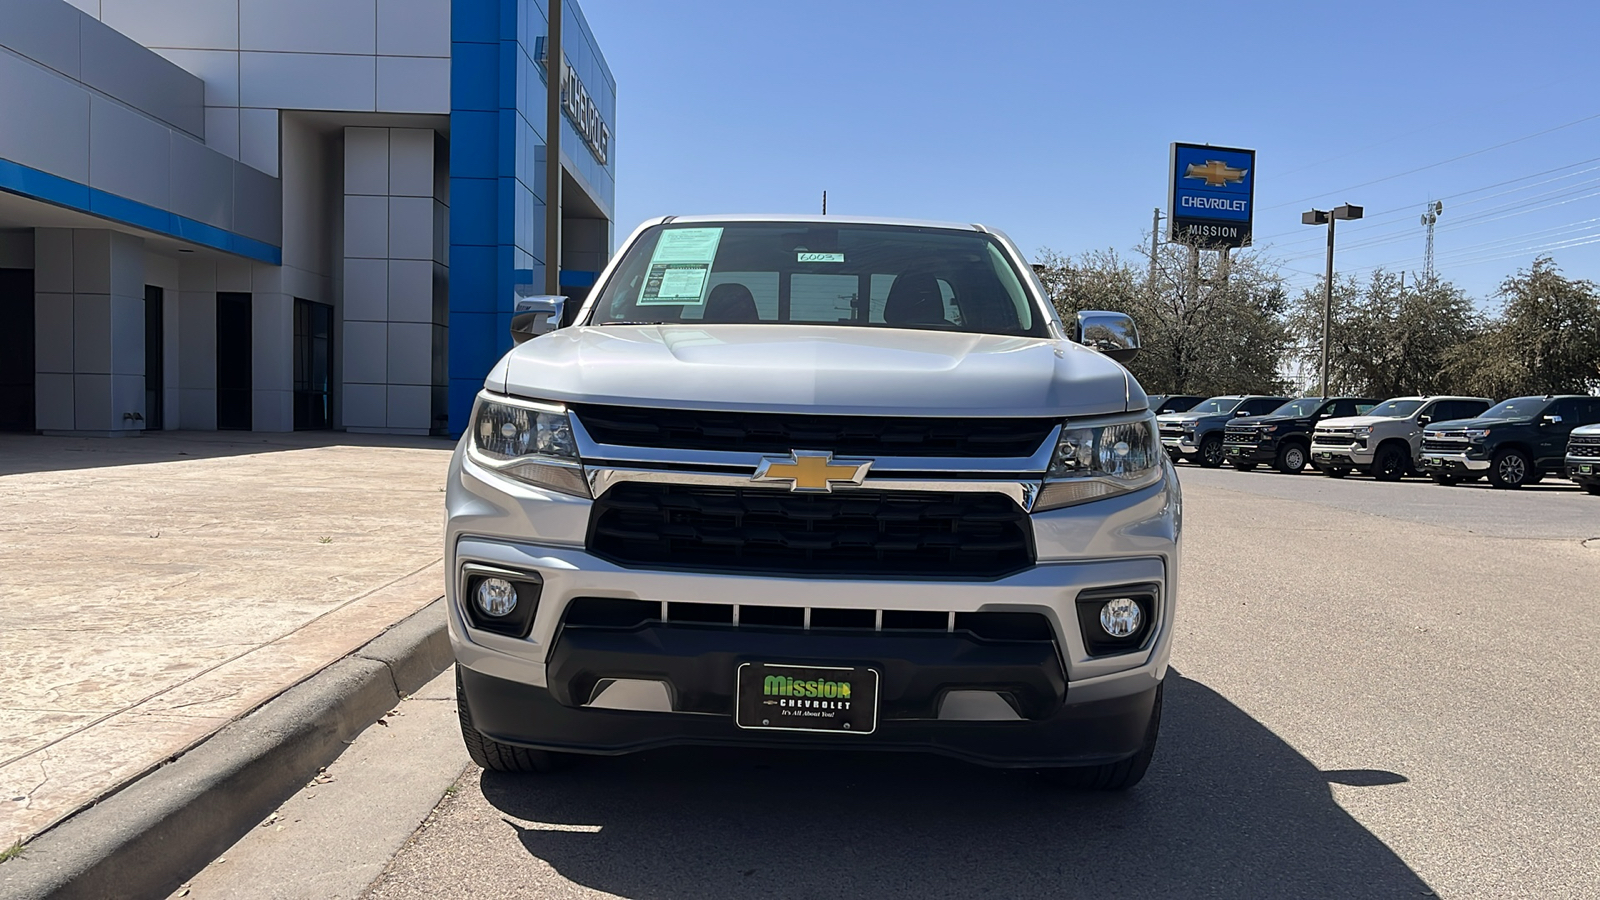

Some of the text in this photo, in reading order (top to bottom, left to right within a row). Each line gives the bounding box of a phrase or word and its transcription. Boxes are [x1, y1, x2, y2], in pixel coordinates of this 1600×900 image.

[569, 66, 609, 162] CHEVROLET
[1181, 196, 1247, 212] CHEVROLET
[1189, 224, 1237, 238] MISSION
[763, 675, 851, 699] Mission
[780, 699, 851, 710] CHEVROLET
